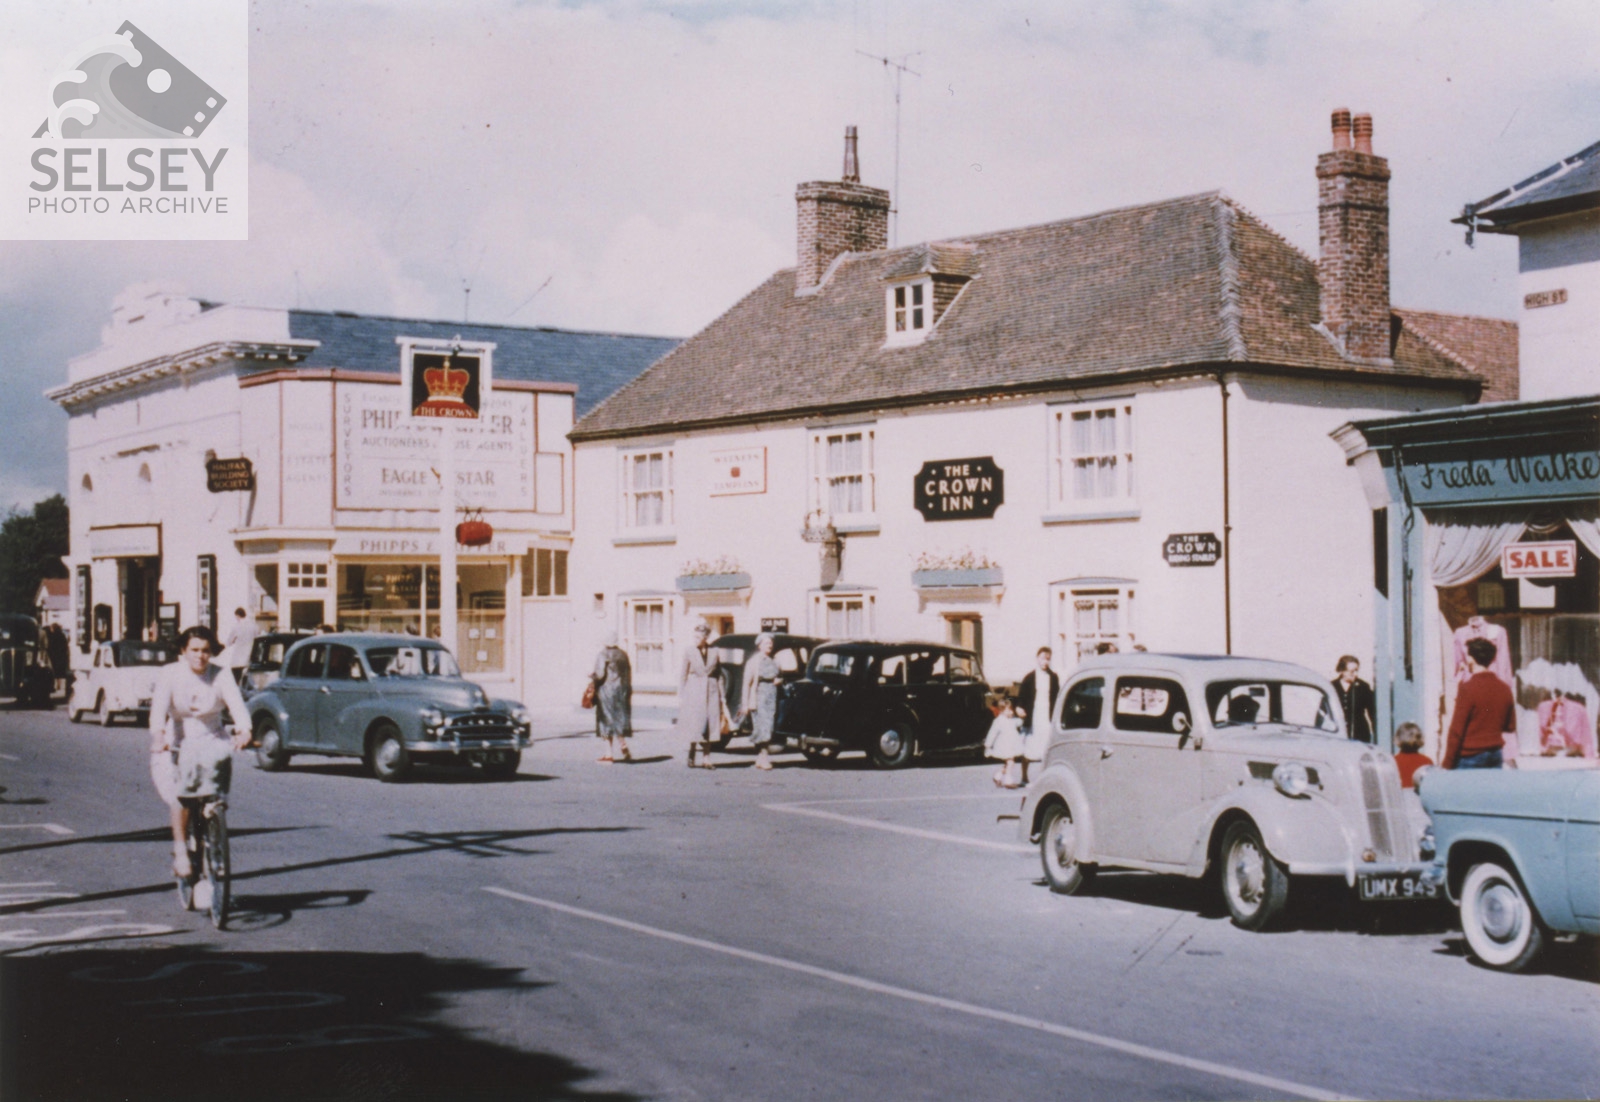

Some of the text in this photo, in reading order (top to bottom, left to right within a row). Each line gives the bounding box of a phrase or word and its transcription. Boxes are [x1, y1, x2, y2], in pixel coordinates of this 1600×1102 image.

[421, 407, 473, 418] THE CROWN
[343, 393, 353, 497] SURVEYORS
[362, 437, 430, 449] AUCTIONEERS
[212, 462, 246, 470] HALIFAX
[944, 464, 970, 477] THE
[1421, 451, 1600, 489] Freda Walke
[210, 471, 249, 479] BUILDING
[382, 467, 495, 486] EAGLE STAR
[214, 480, 248, 488] SOCIETY
[925, 477, 992, 496] CROWN
[942, 496, 973, 512] INN
[360, 540, 419, 551] PHIPPS
[1167, 542, 1216, 554] CROWN
[1509, 550, 1569, 569] SALE
